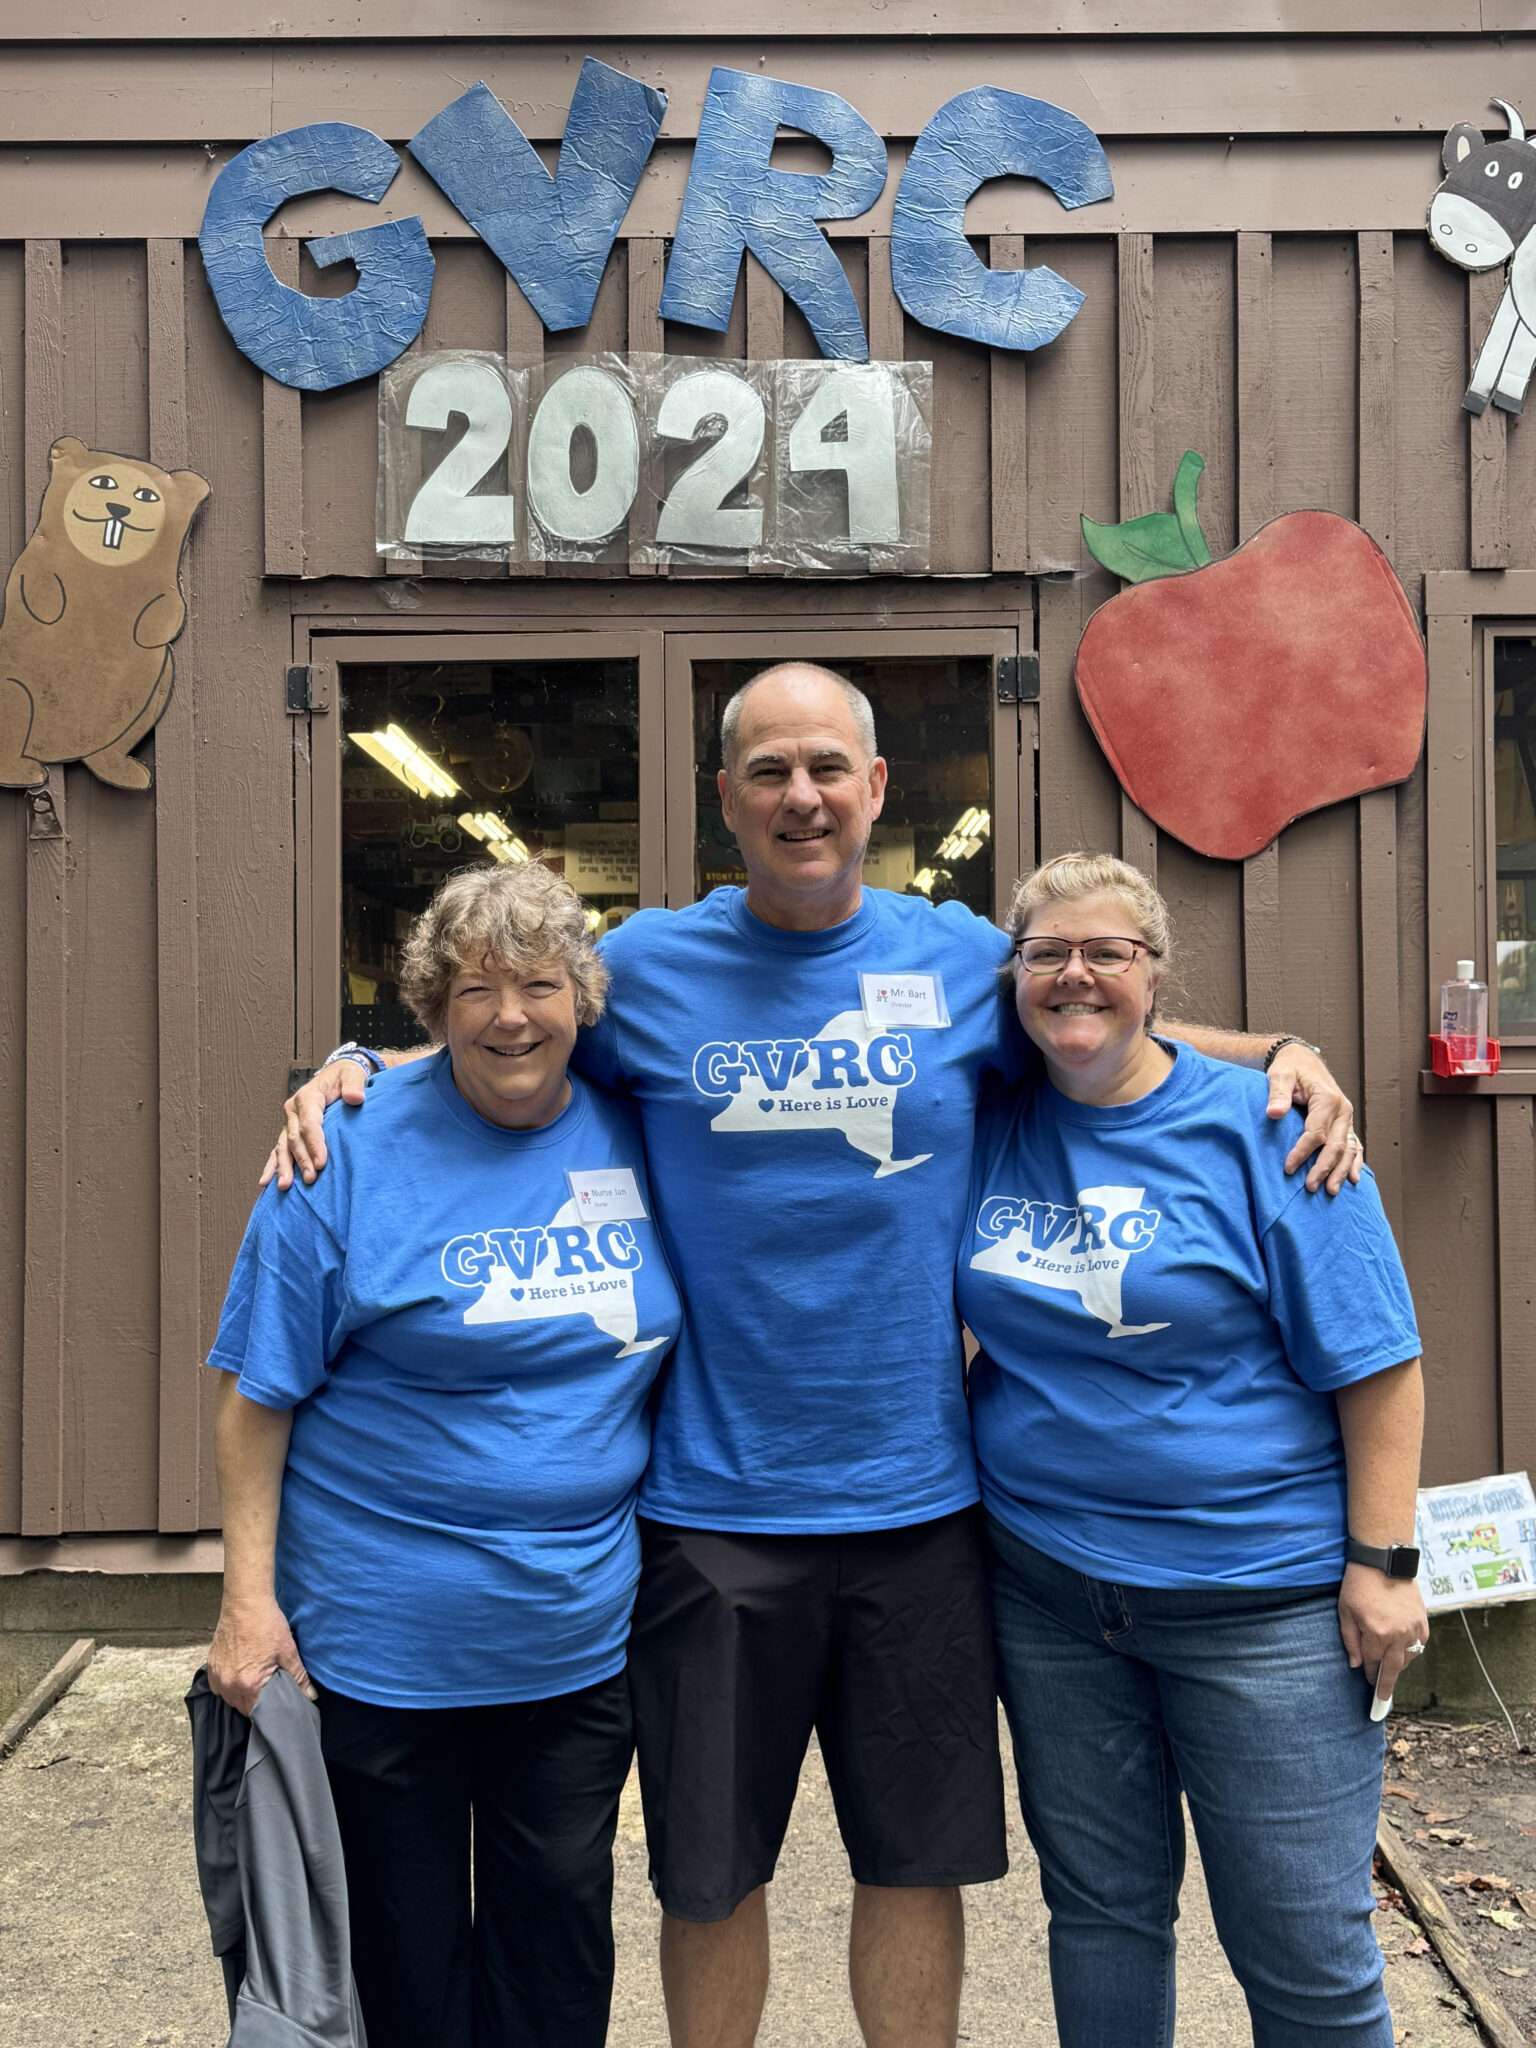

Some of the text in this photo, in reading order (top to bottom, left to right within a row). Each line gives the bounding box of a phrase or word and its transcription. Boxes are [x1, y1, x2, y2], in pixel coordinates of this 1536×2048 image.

[199, 55, 1116, 393] GVRC
[403, 361, 903, 549] 2024
[373, 787, 408, 800] ROCK
[705, 871, 733, 881] STONY
[890, 988, 927, 1000] Mr. Bart
[692, 1033, 916, 1098] GVRC
[779, 1096, 889, 1112] Here is Love
[591, 1187, 627, 1197] Nurse Jan
[976, 1195, 1161, 1255] GVRC
[440, 1220, 644, 1288] GVRC
[1032, 1257, 1120, 1274] Here is Love
[528, 1278, 628, 1301] Here is Love
[1483, 1488, 1525, 1513] CENTER
